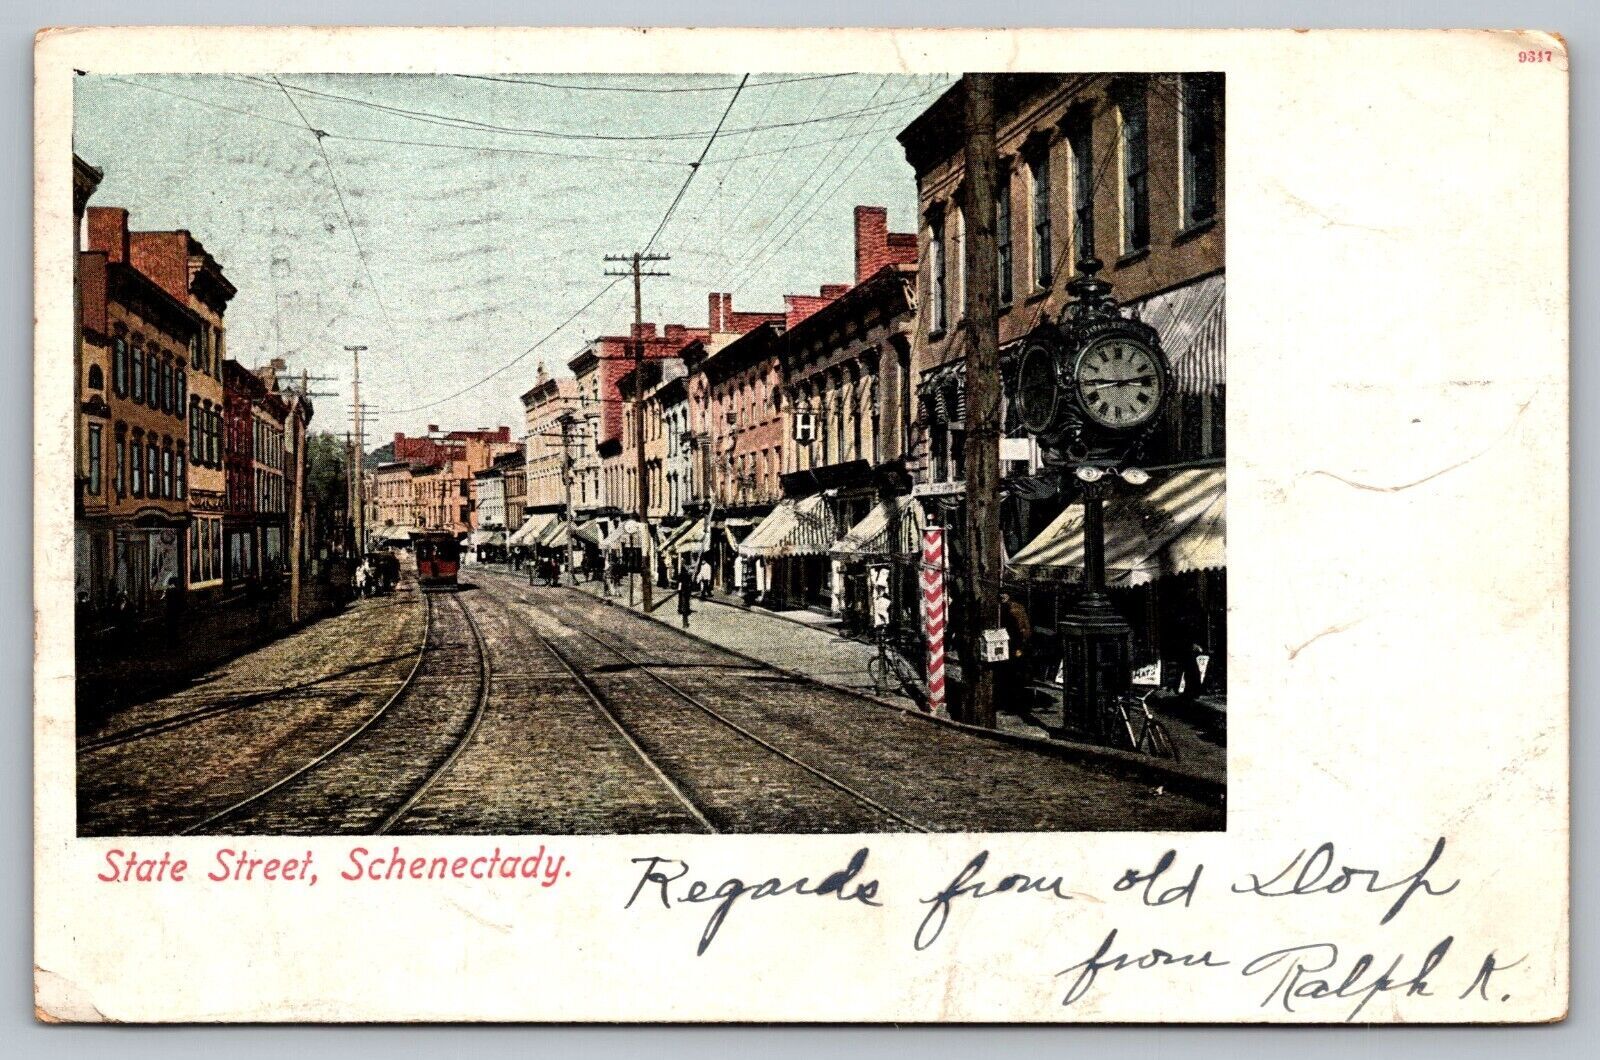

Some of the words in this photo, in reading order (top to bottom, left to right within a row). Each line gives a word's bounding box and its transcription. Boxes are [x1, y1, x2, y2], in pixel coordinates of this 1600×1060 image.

[796, 414, 816, 440] H
[98, 850, 187, 882] State
[208, 849, 318, 887] Street,
[341, 846, 571, 888] Schenectady.
[625, 848, 882, 955] Regards
[915, 851, 1074, 950] from
[1114, 850, 1203, 906] old
[1057, 929, 1230, 1005] from
[1243, 936, 1453, 1022] Ralph
